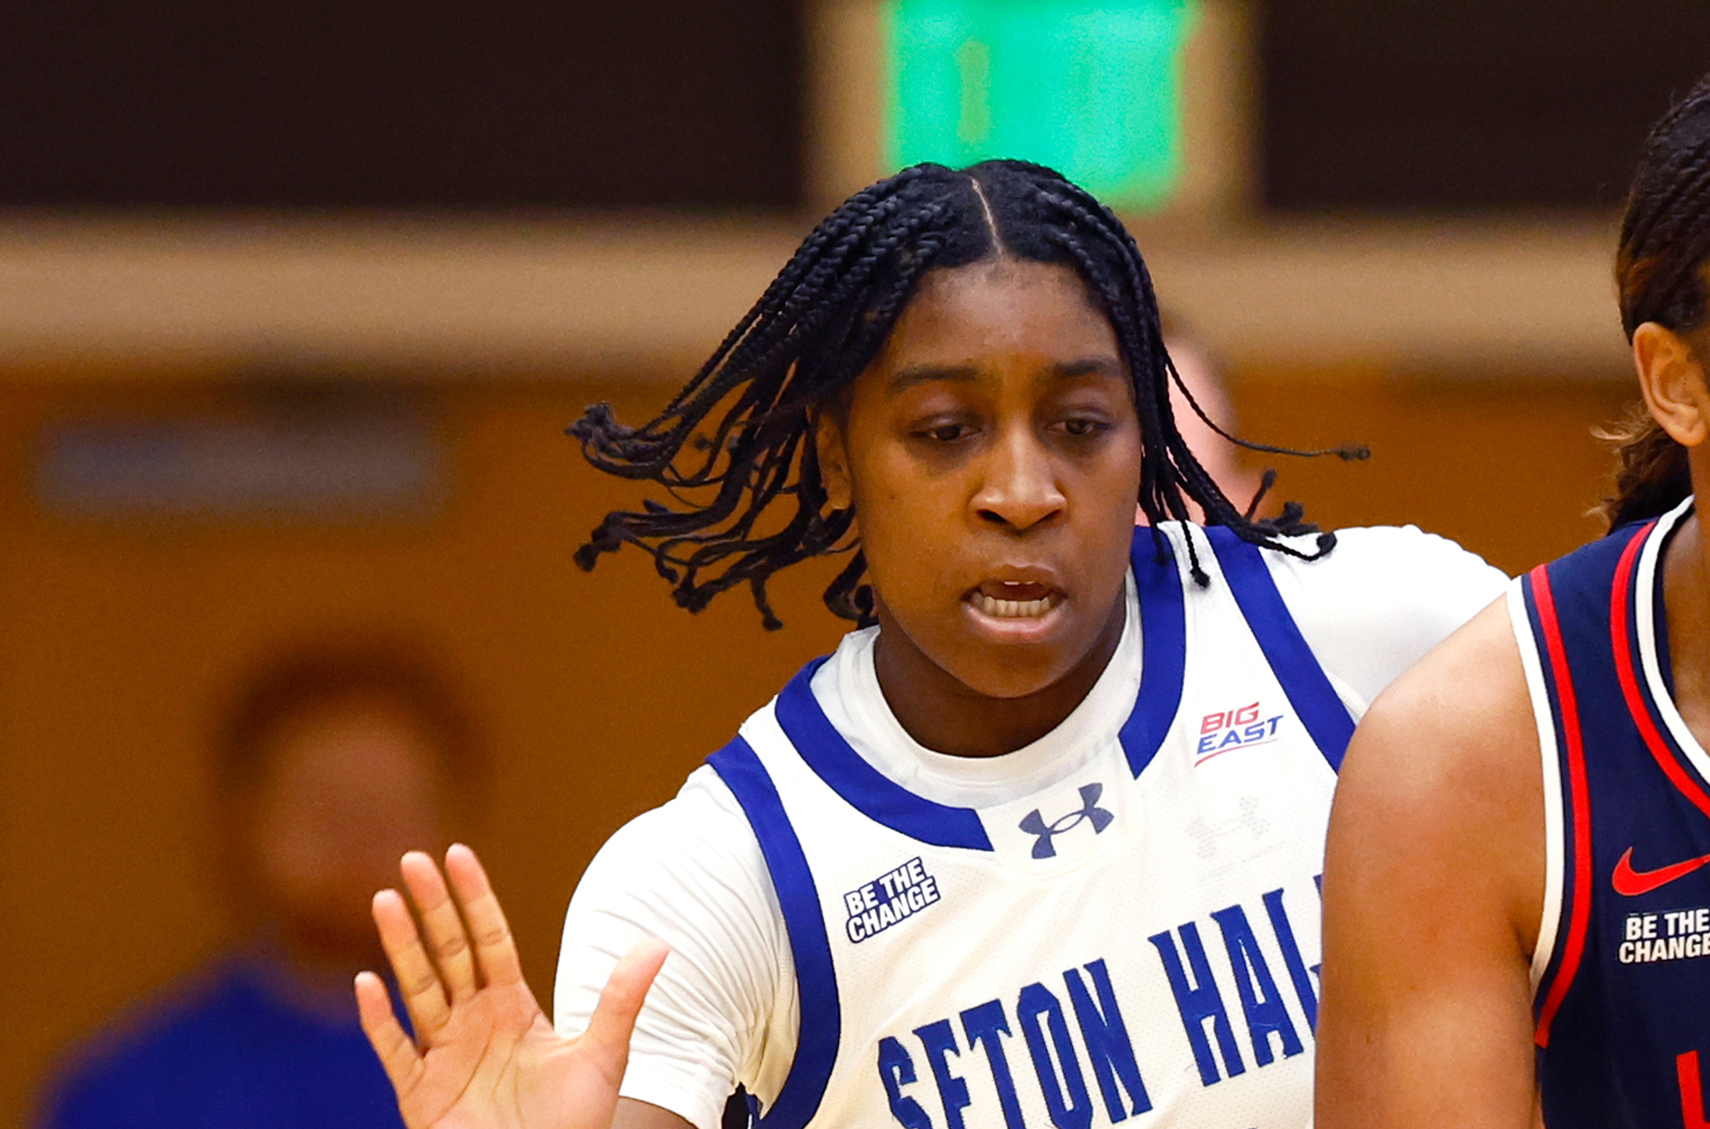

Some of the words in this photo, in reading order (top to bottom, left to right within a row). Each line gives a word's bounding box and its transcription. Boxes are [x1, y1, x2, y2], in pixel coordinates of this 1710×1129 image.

[1196, 714, 1284, 755] EAST
[1200, 701, 1260, 735] BIG
[844, 883, 880, 917] BE
[879, 857, 926, 900] THE
[847, 876, 940, 942] CHANGE
[1626, 914, 1658, 941] BE
[1664, 908, 1710, 937] THE
[1148, 873, 1323, 1088] HAL
